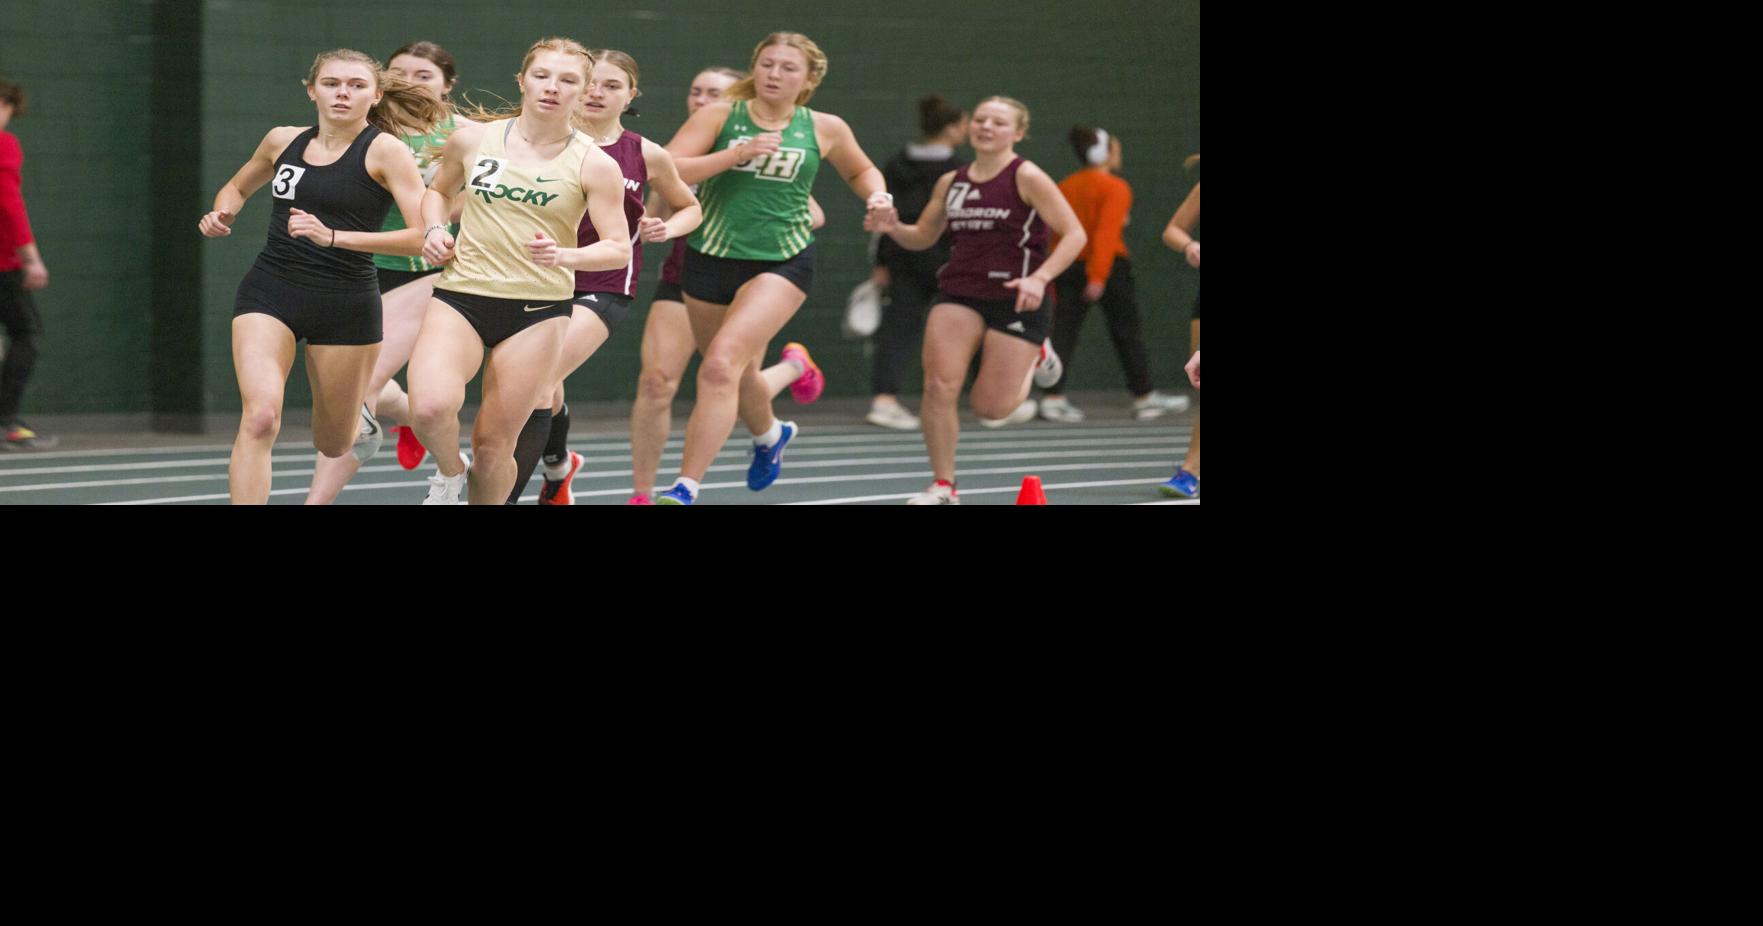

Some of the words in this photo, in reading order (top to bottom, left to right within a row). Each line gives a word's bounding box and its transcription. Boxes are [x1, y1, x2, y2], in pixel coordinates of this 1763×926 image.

[274, 168, 295, 196] 3
[471, 159, 500, 189] 2
[948, 185, 964, 207] 7
